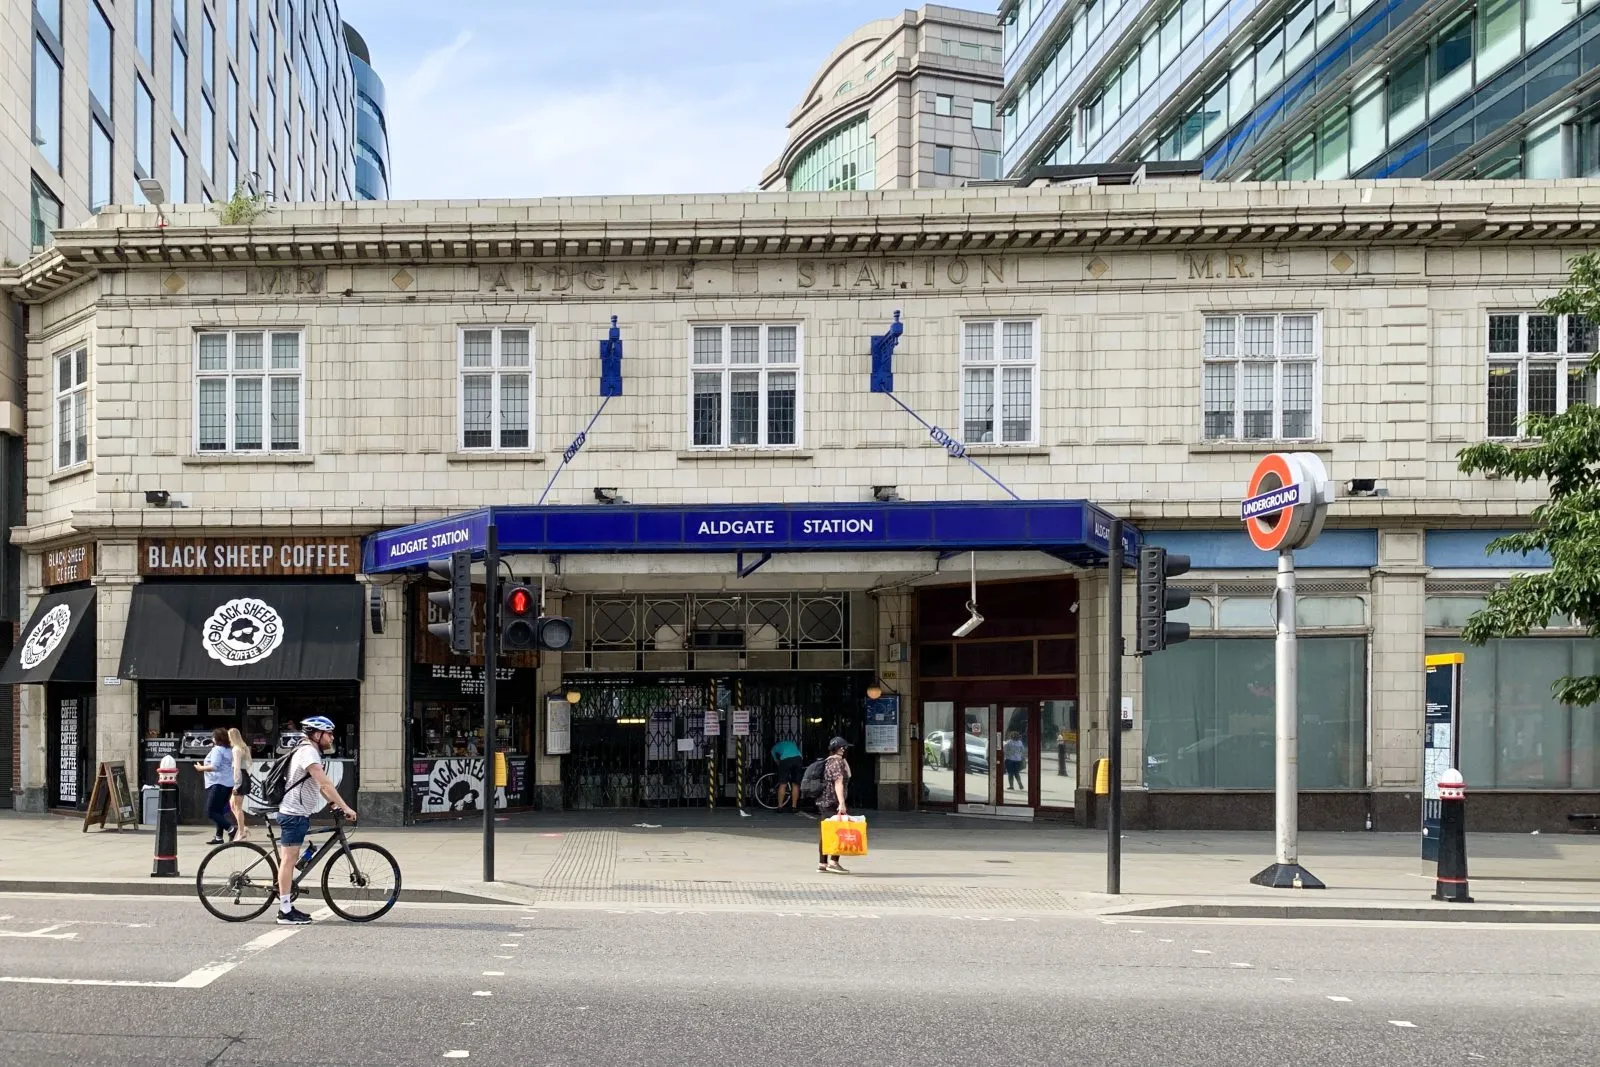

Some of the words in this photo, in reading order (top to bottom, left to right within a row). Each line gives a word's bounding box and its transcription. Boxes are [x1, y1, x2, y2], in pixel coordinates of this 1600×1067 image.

[489, 264, 694, 291] ALDGATE
[799, 257, 1005, 287] STATION
[1184, 252, 1254, 279] M.R.
[1243, 489, 1297, 515] UNDERGROUND
[698, 520, 775, 535] ALDGATE
[803, 519, 873, 534] STATION
[67, 547, 86, 563] SHEEP
[390, 538, 428, 557] ALDGATE
[431, 528, 469, 548] STATION
[148, 546, 208, 568] BLACK
[214, 545, 274, 567] SHEEP
[280, 545, 349, 567] COFFEE
[209, 604, 242, 632] BLACK
[243, 602, 277, 624] SHEEP
[228, 647, 260, 660] COFFEE
[428, 760, 458, 806] BLACK
